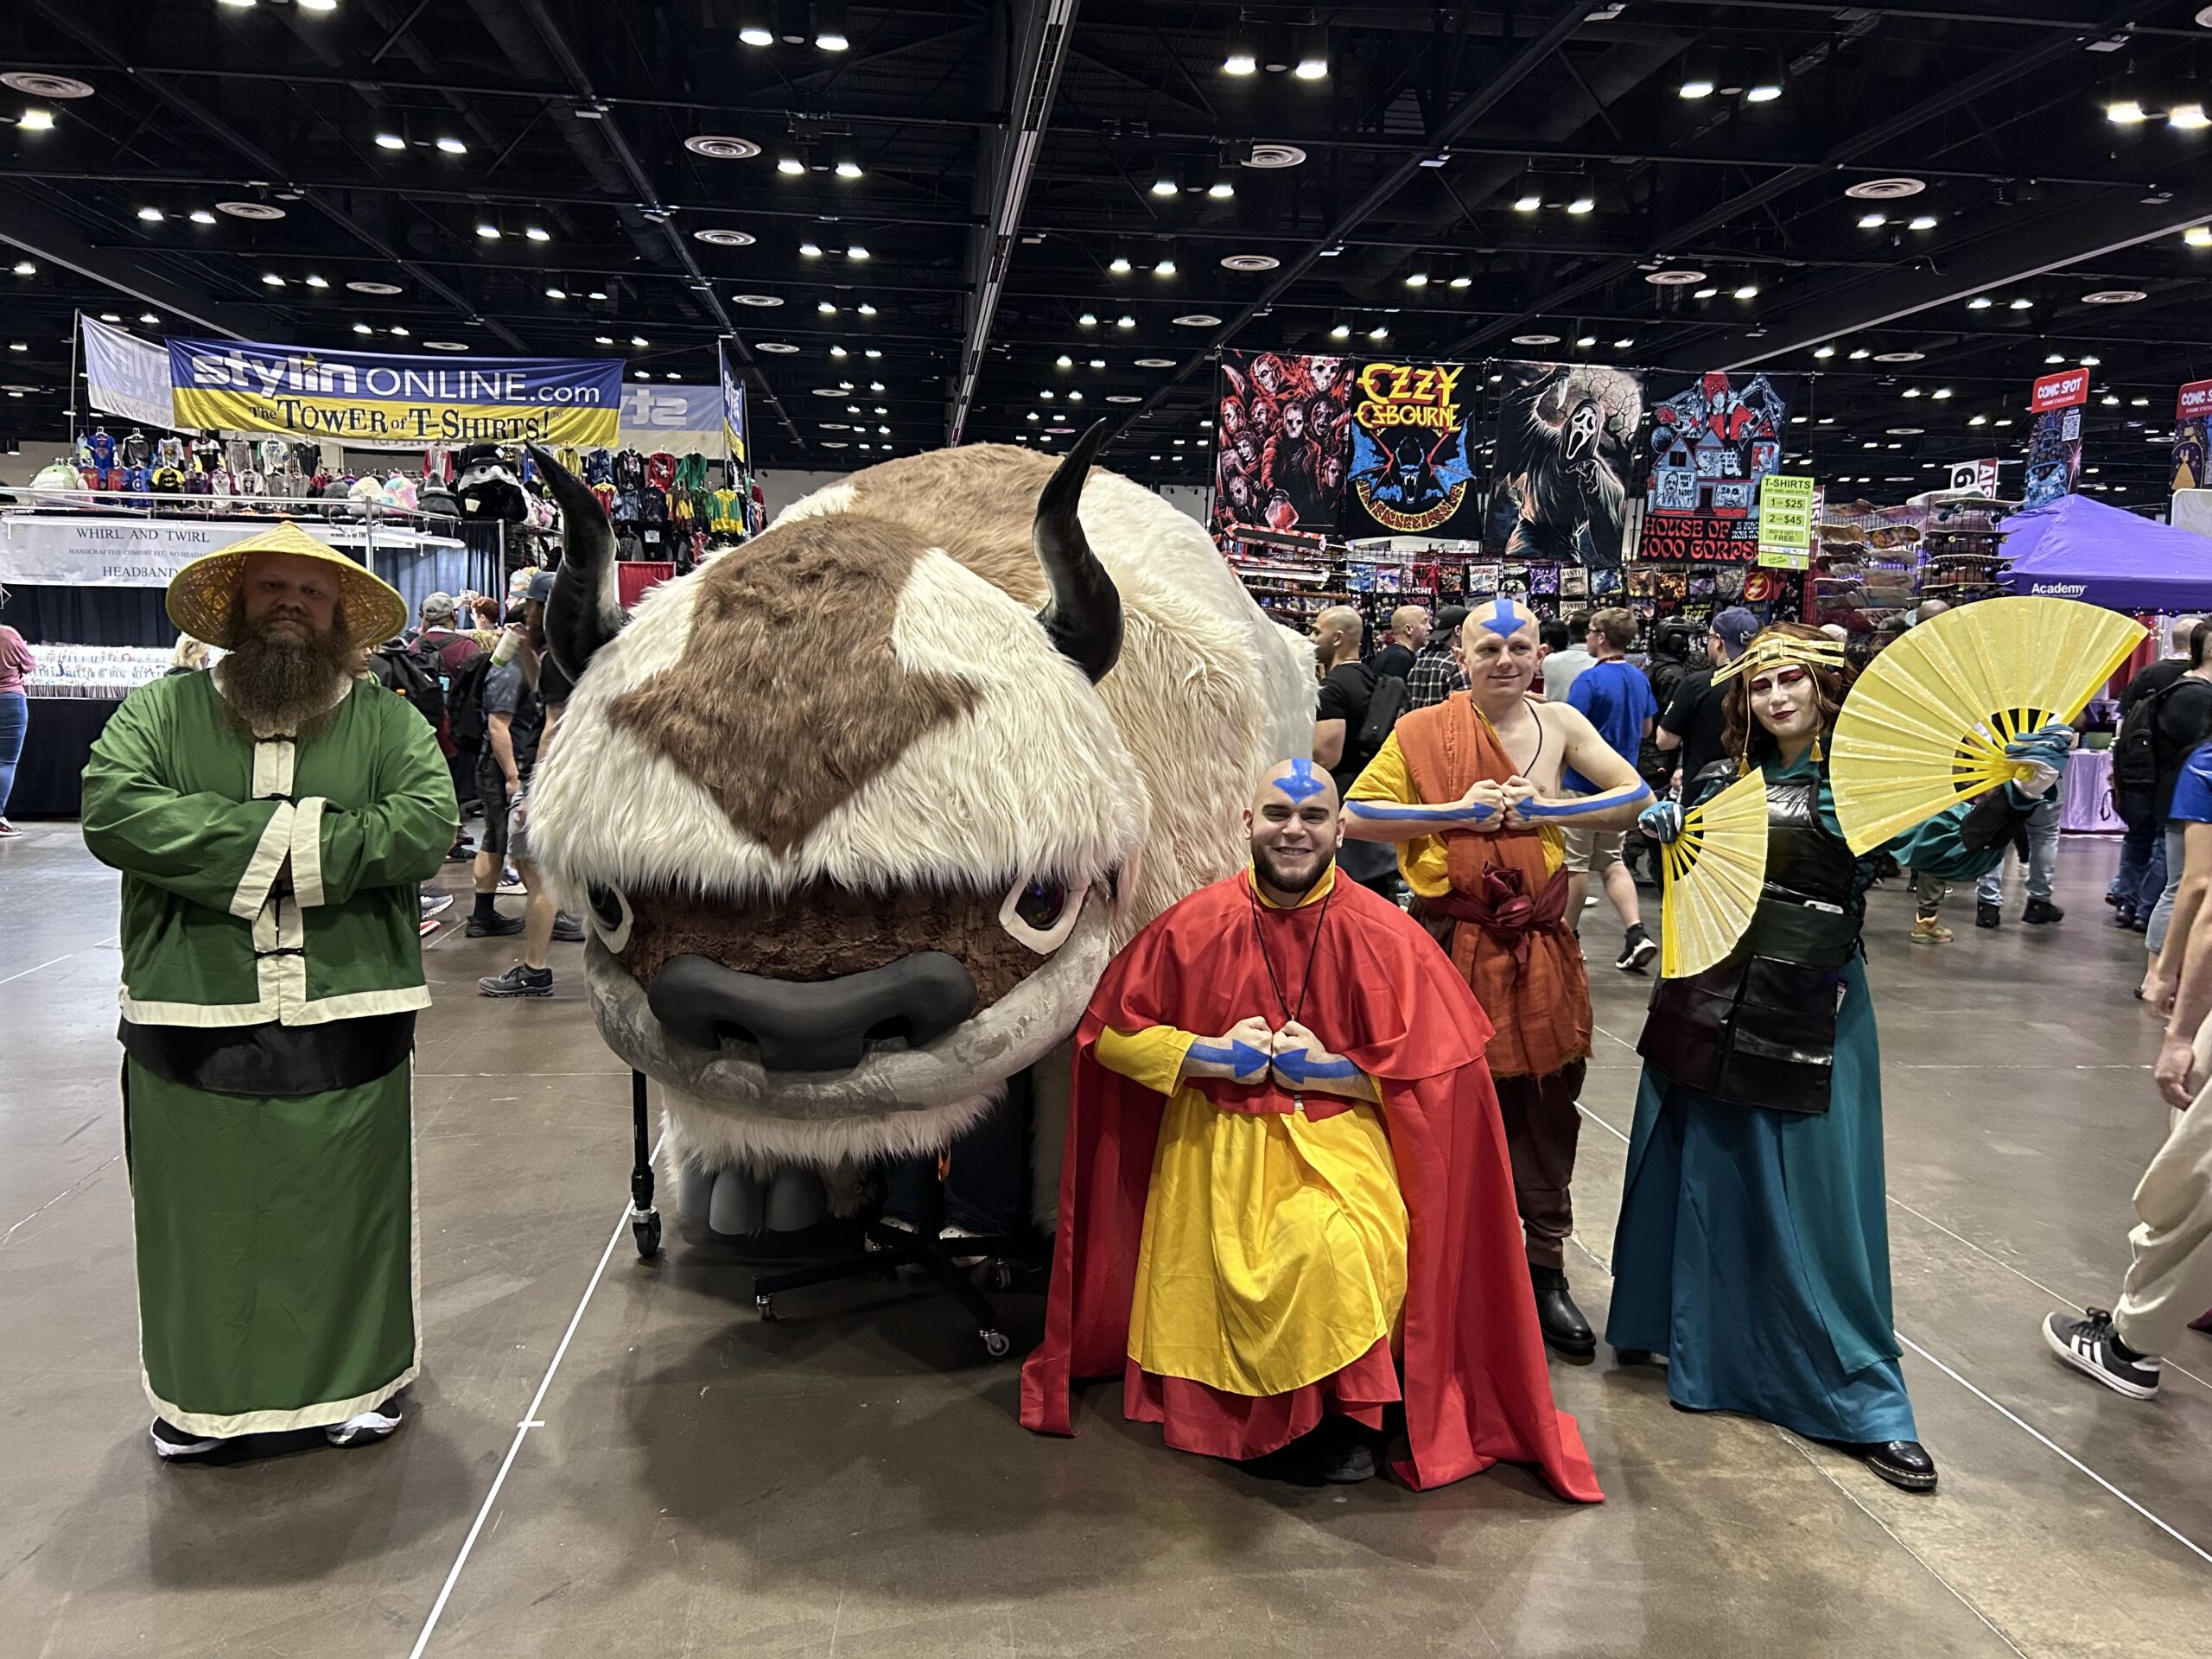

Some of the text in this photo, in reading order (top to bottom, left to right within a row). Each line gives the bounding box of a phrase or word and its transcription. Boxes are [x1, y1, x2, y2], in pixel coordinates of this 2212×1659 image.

[192, 350, 357, 398] stylin
[2037, 377, 2083, 399] COMIC SPOT
[2181, 391, 2206, 407] COMIC
[249, 406, 277, 420] The
[276, 399, 389, 434] TOWER
[391, 417, 408, 429] of
[409, 408, 549, 440] T-SHIRTS!
[1764, 478, 1811, 490] T-SHIRTS
[1770, 498, 1776, 507] 1
[1784, 499, 1803, 509] $25
[1643, 517, 1731, 538] HOUSE OF
[1770, 514, 1776, 523] 2
[1783, 515, 1802, 525] $45
[76, 527, 210, 543] WHIRL AND TWIRL
[1732, 531, 1747, 540] ROB
[1773, 534, 1795, 543] FREE
[1642, 537, 1686, 559] 1000
[2031, 582, 2085, 597] Academy
